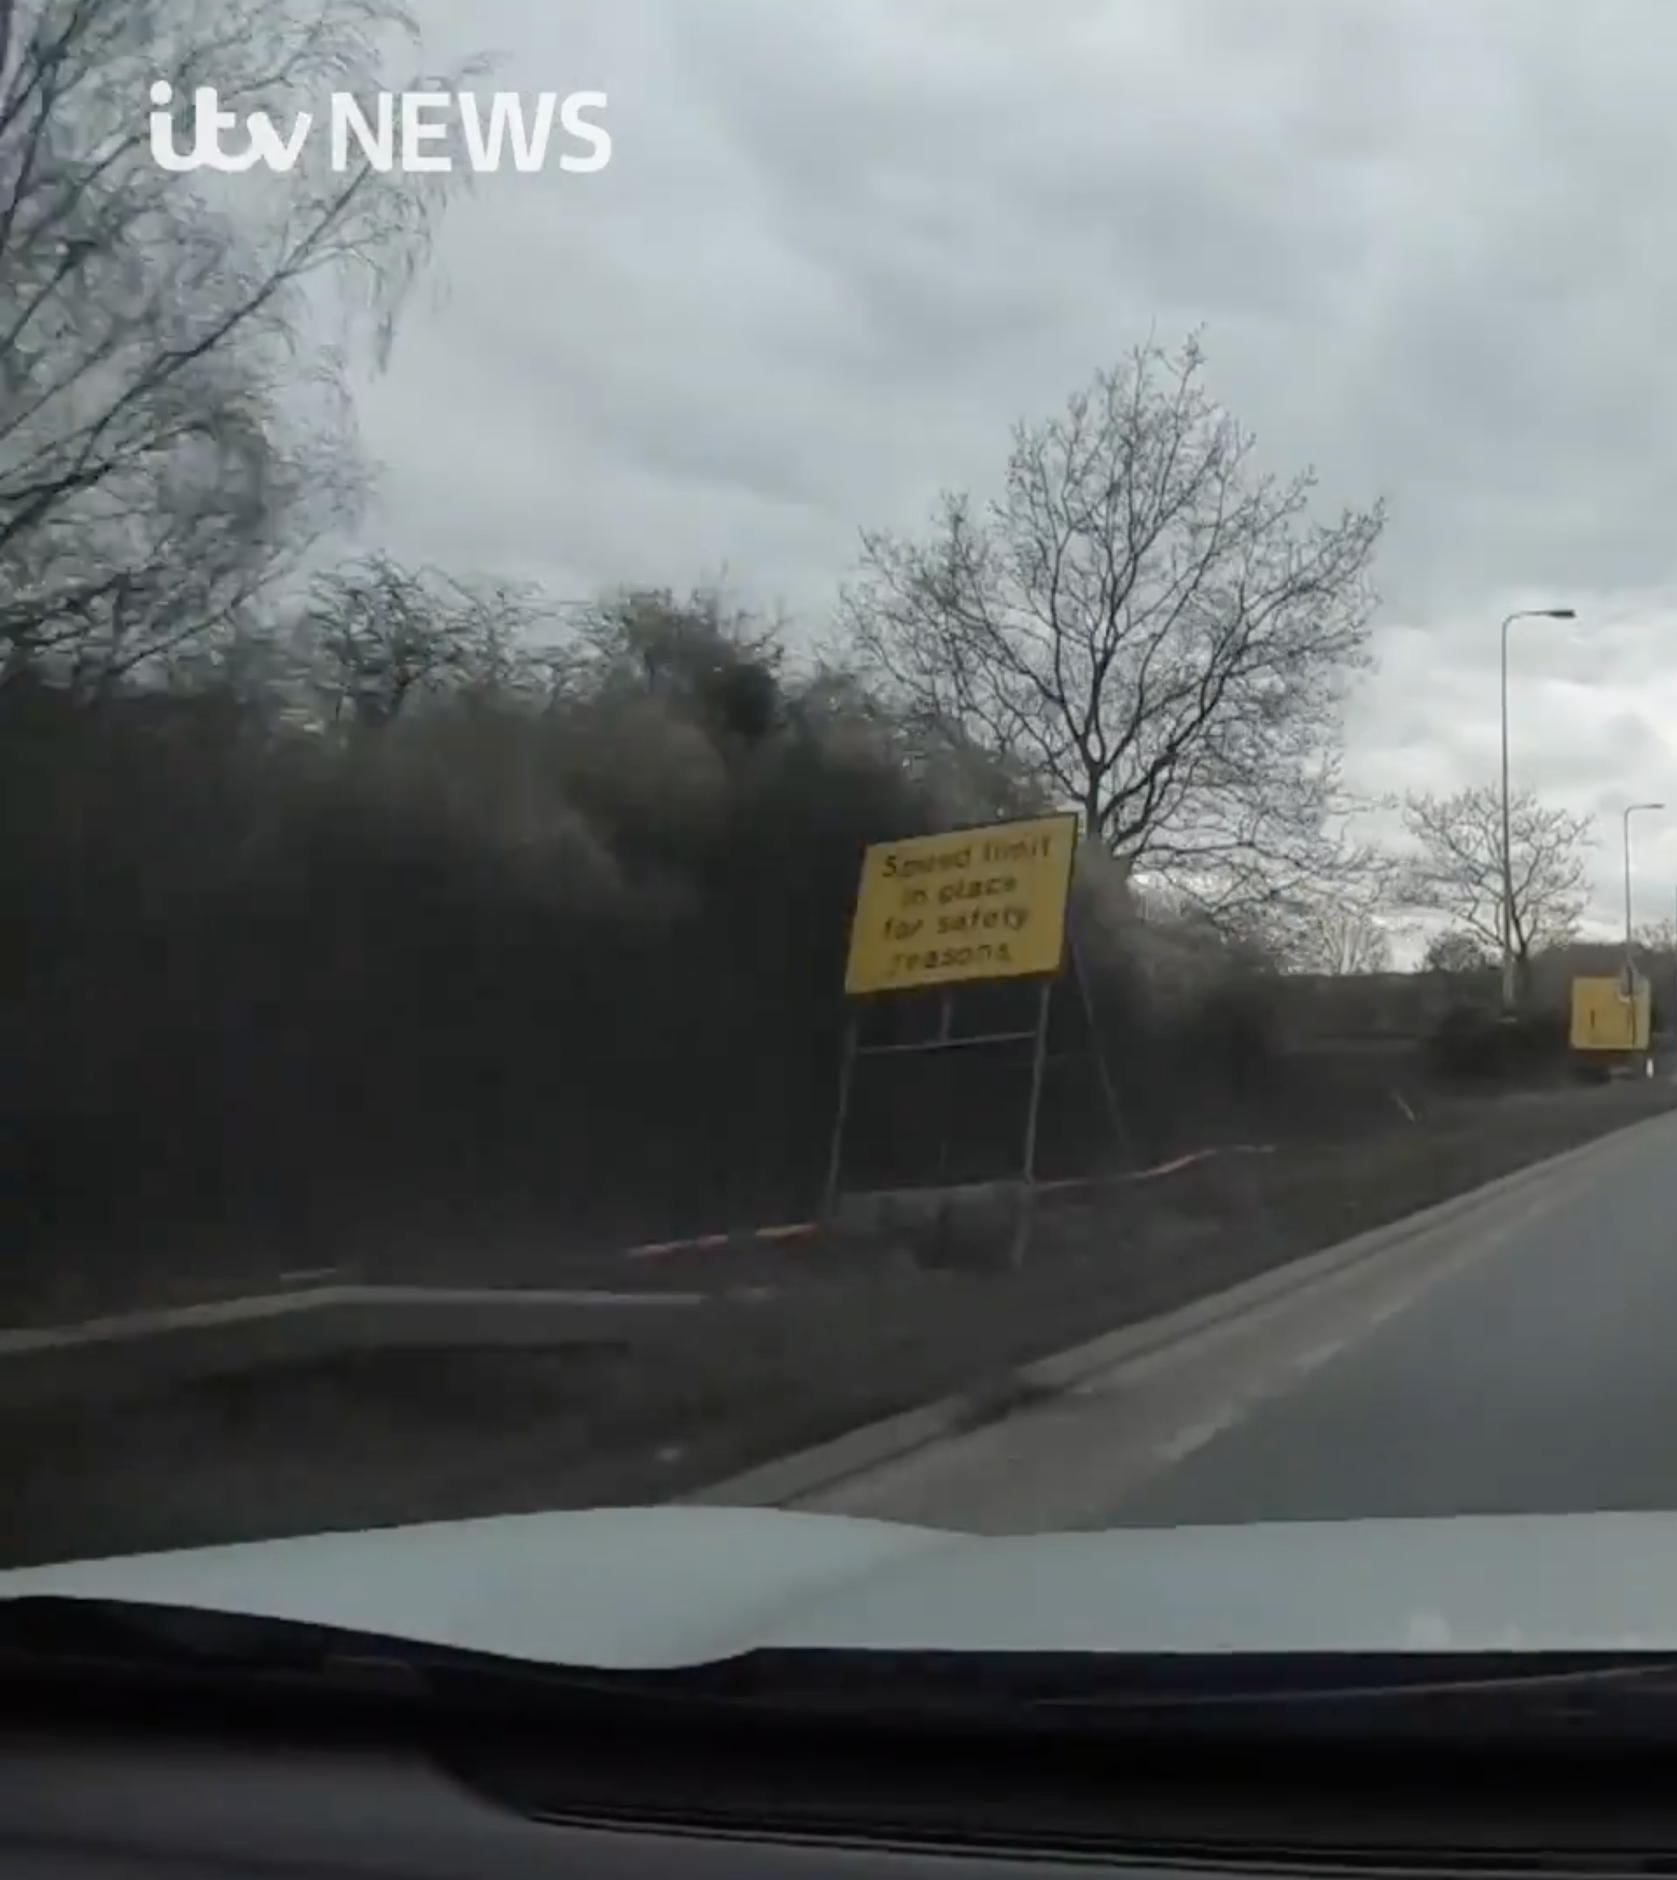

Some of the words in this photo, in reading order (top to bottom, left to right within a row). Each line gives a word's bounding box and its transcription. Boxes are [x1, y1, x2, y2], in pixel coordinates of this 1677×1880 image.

[882, 848, 972, 878] Speed
[983, 835, 1051, 863] limit
[938, 875, 1017, 907] place
[884, 917, 924, 941] for
[937, 906, 1031, 934] safety
[893, 943, 1013, 971] reasons
